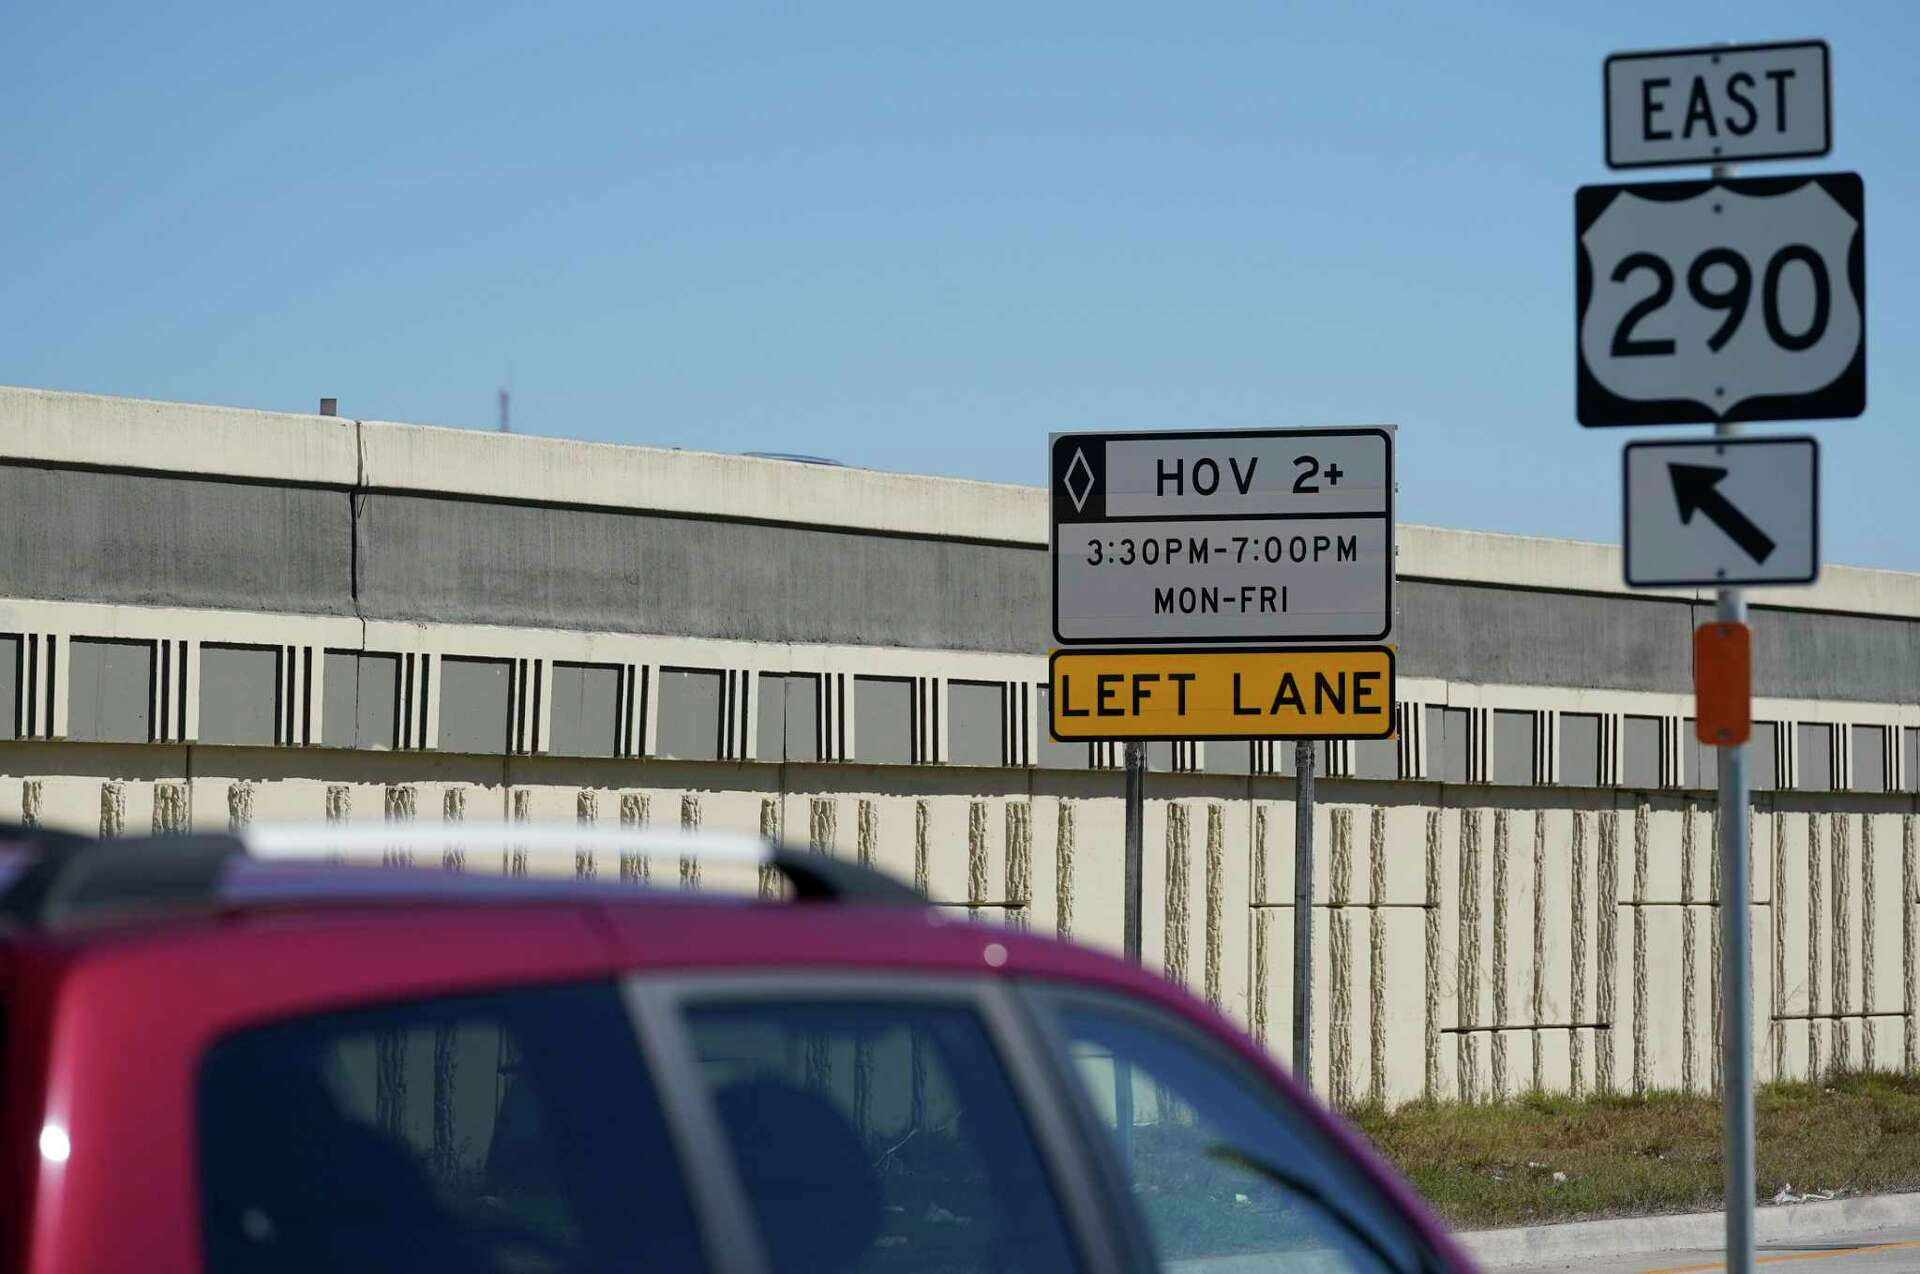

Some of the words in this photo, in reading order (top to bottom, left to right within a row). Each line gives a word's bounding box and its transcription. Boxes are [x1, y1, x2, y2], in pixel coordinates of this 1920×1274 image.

[1641, 69, 1796, 141] EAST
[1610, 243, 1831, 357] 290
[1156, 457, 1258, 496] HOV
[1292, 455, 1344, 493] 2+
[1087, 535, 1357, 566] 3:30PM-7:00PM
[1154, 586, 1288, 614] MON-FRI
[1062, 673, 1196, 717] LEFT
[1233, 671, 1382, 715] LANE
